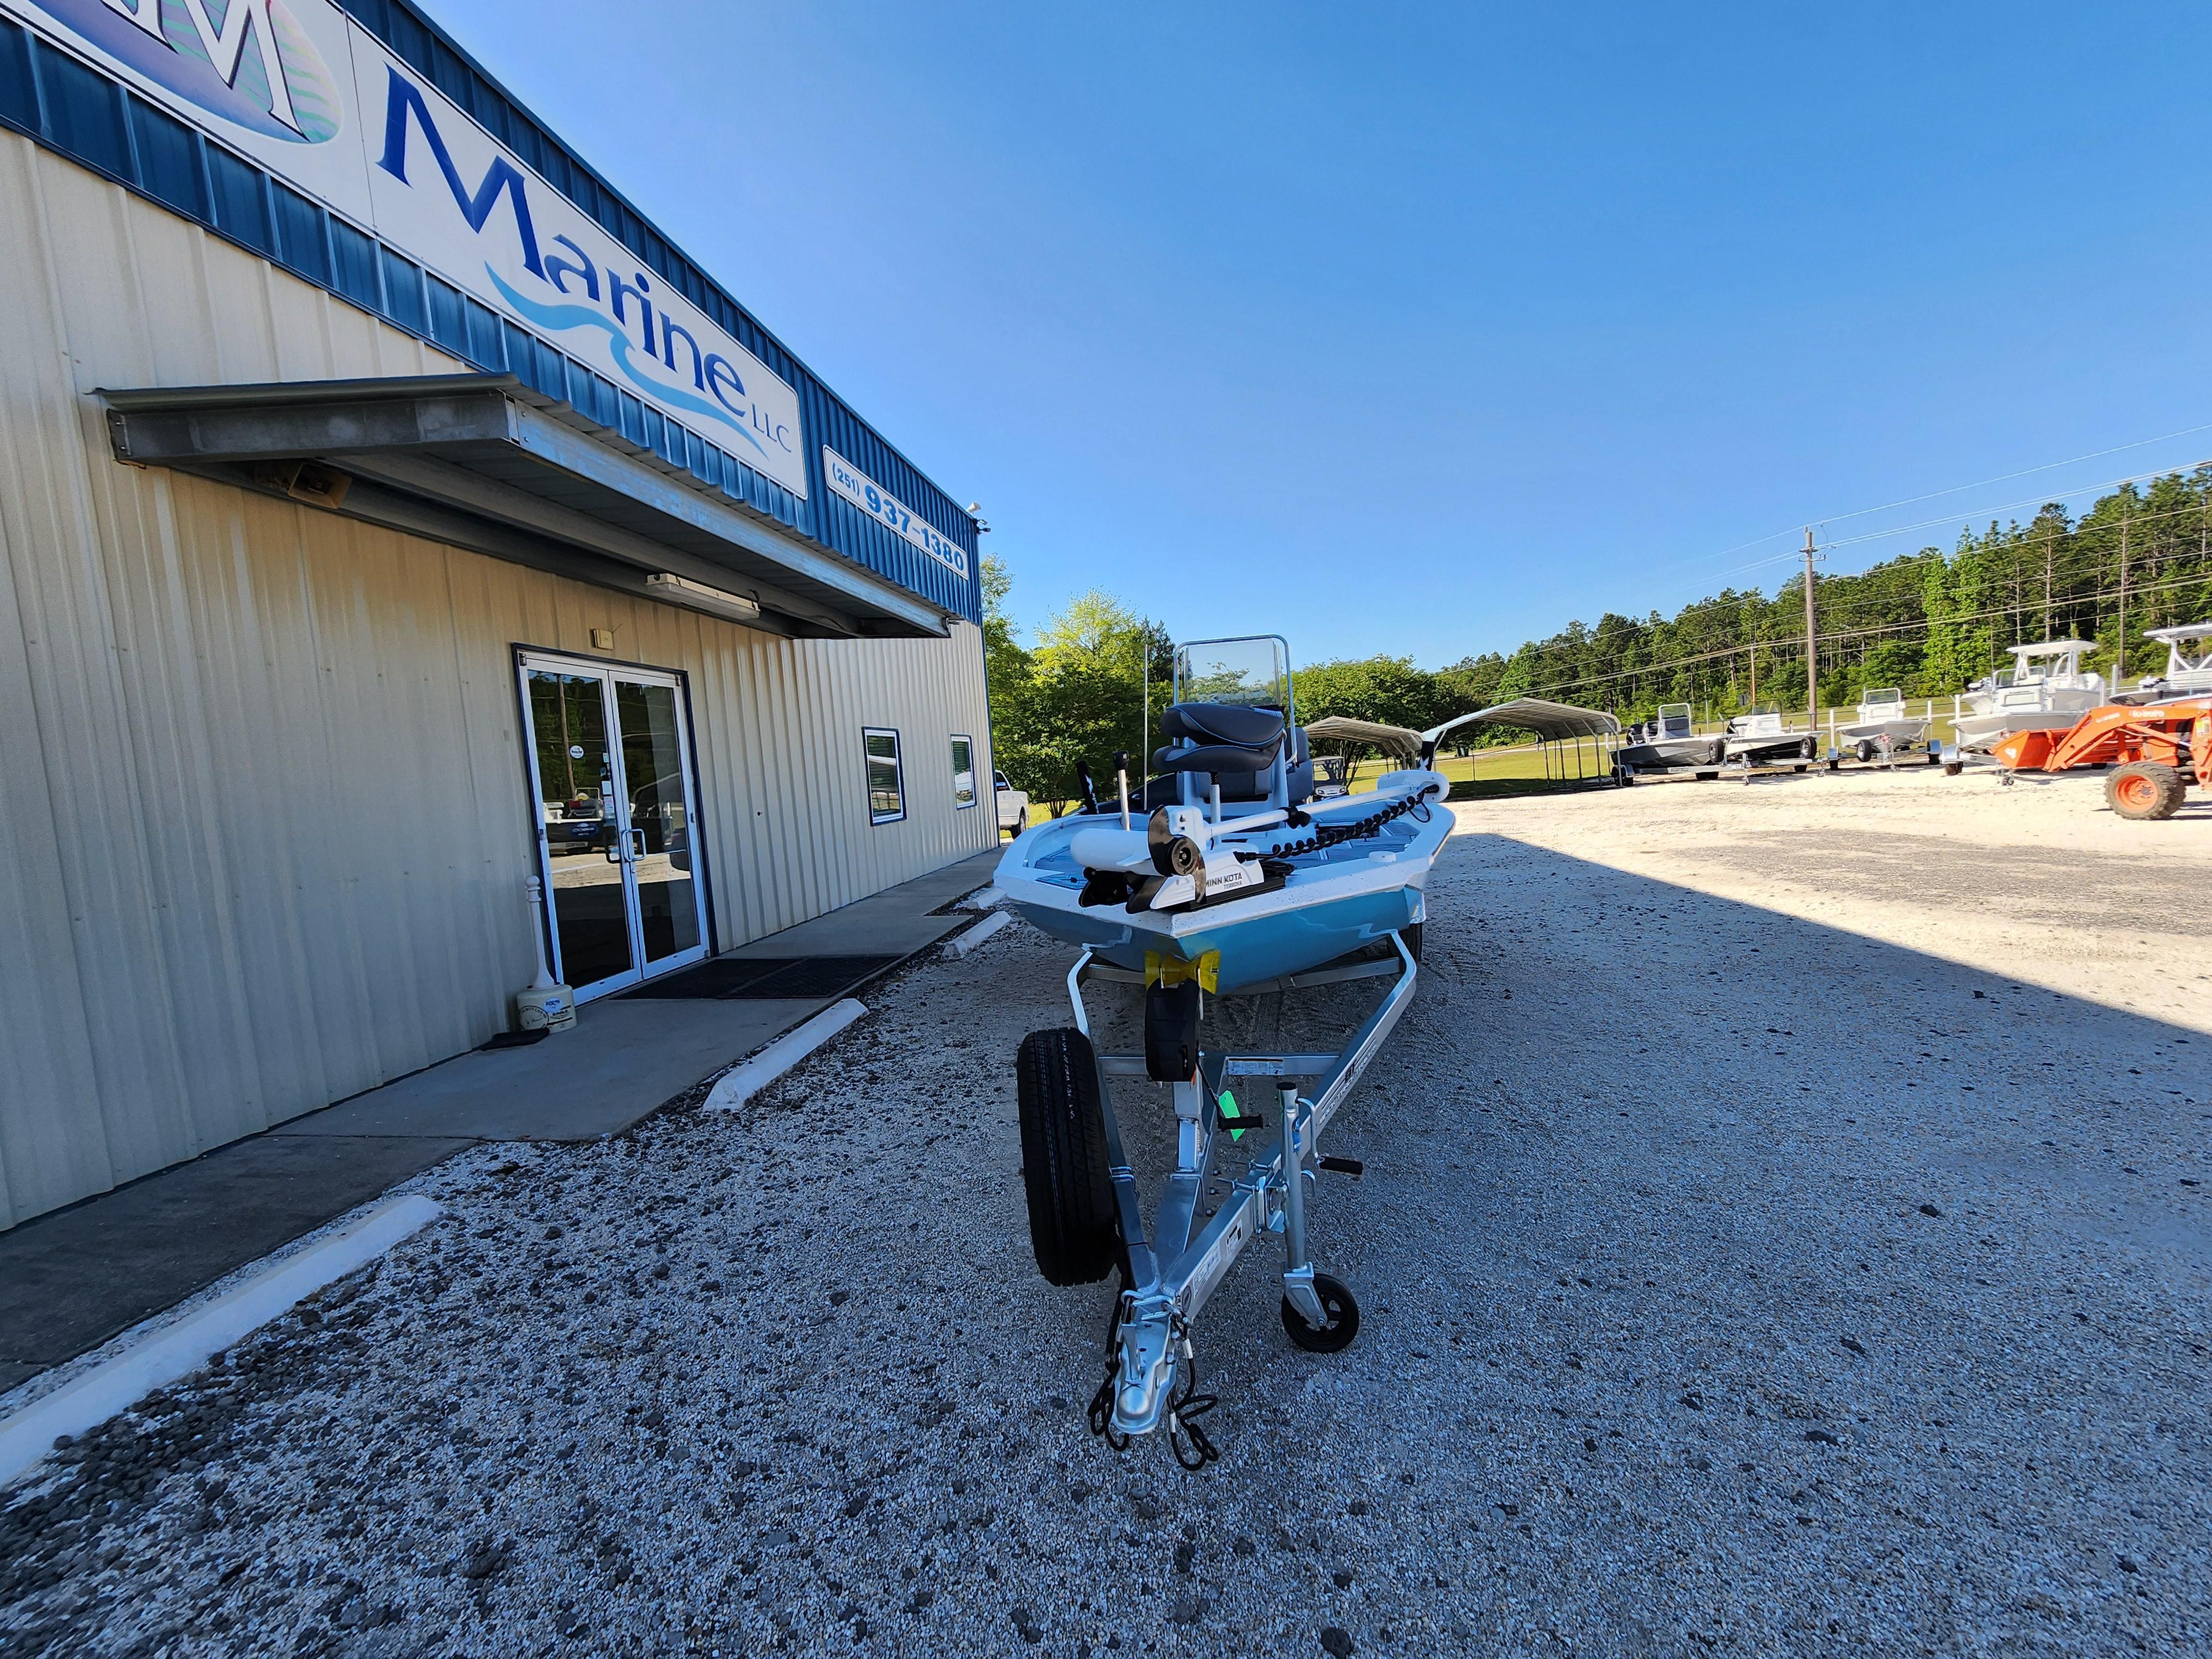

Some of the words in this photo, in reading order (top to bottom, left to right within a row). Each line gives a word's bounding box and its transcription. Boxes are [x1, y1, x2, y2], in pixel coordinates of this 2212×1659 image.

[374, 60, 746, 418] Marine
[751, 404, 792, 453] LLC
[832, 462, 860, 497] (251)
[864, 484, 964, 571] 937-1380
[1224, 872, 1243, 883] KOTA
